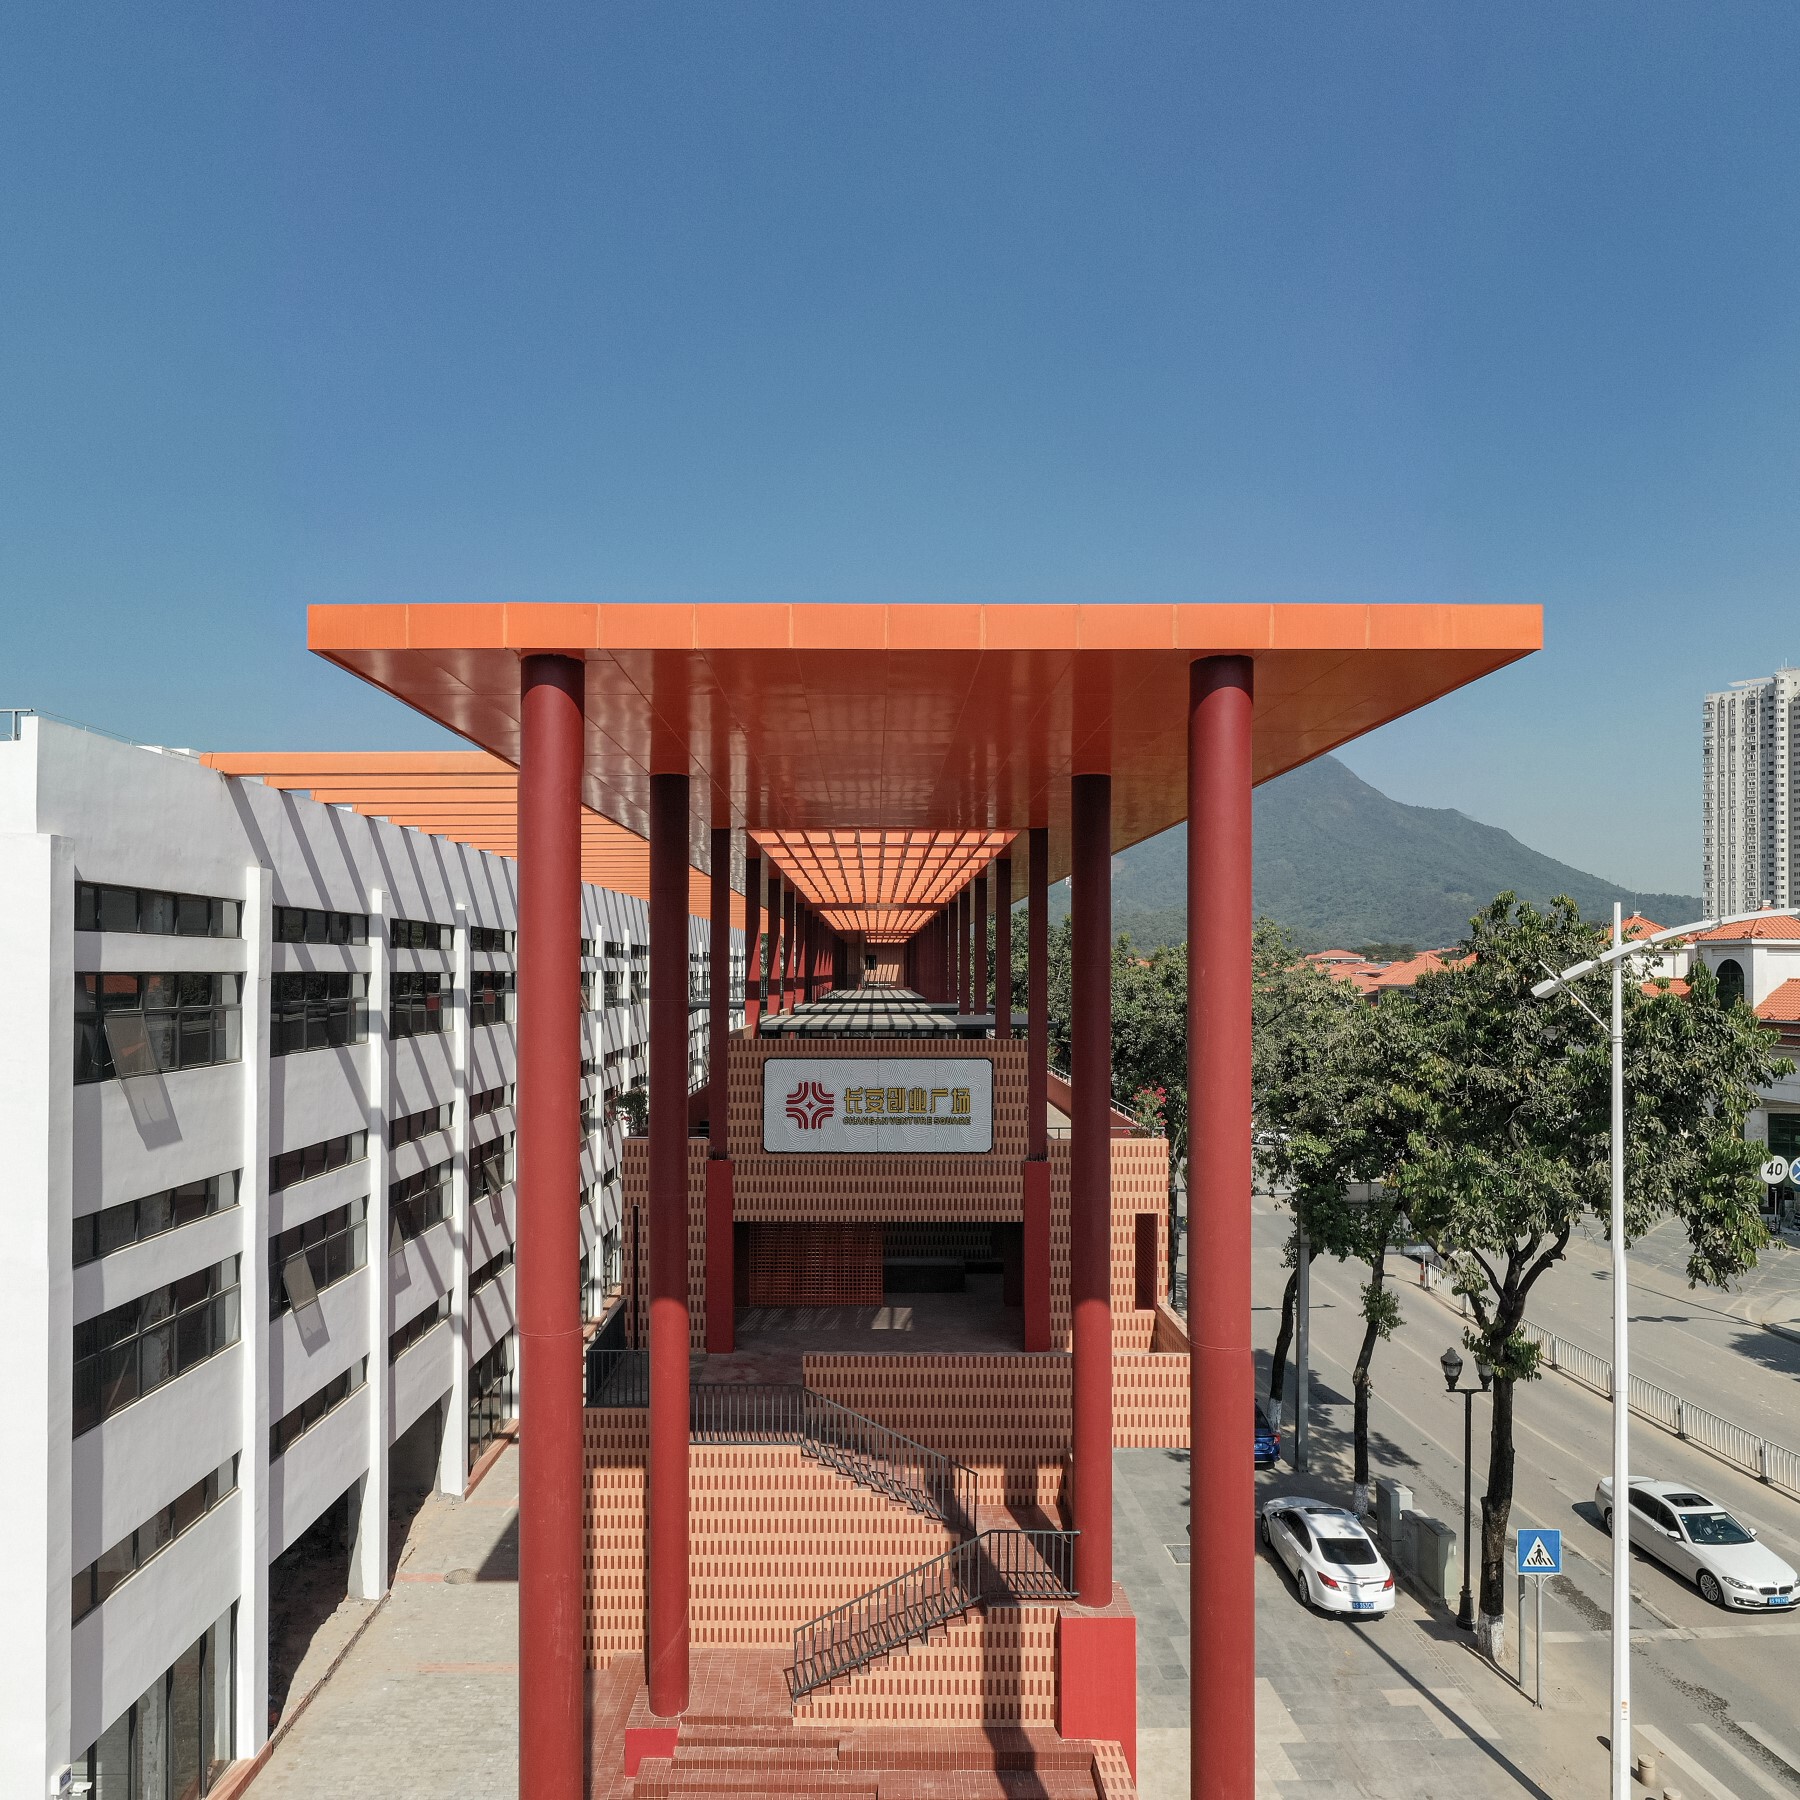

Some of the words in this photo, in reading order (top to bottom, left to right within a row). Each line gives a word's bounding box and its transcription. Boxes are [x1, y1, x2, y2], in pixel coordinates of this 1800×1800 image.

[844, 1087, 971, 1114] 长安创业广场
[843, 1116, 888, 1125] CHANGAN
[890, 1116, 932, 1125] VENTURE
[933, 1116, 971, 1125] SQUARE
[1767, 1163, 1782, 1176] 40
